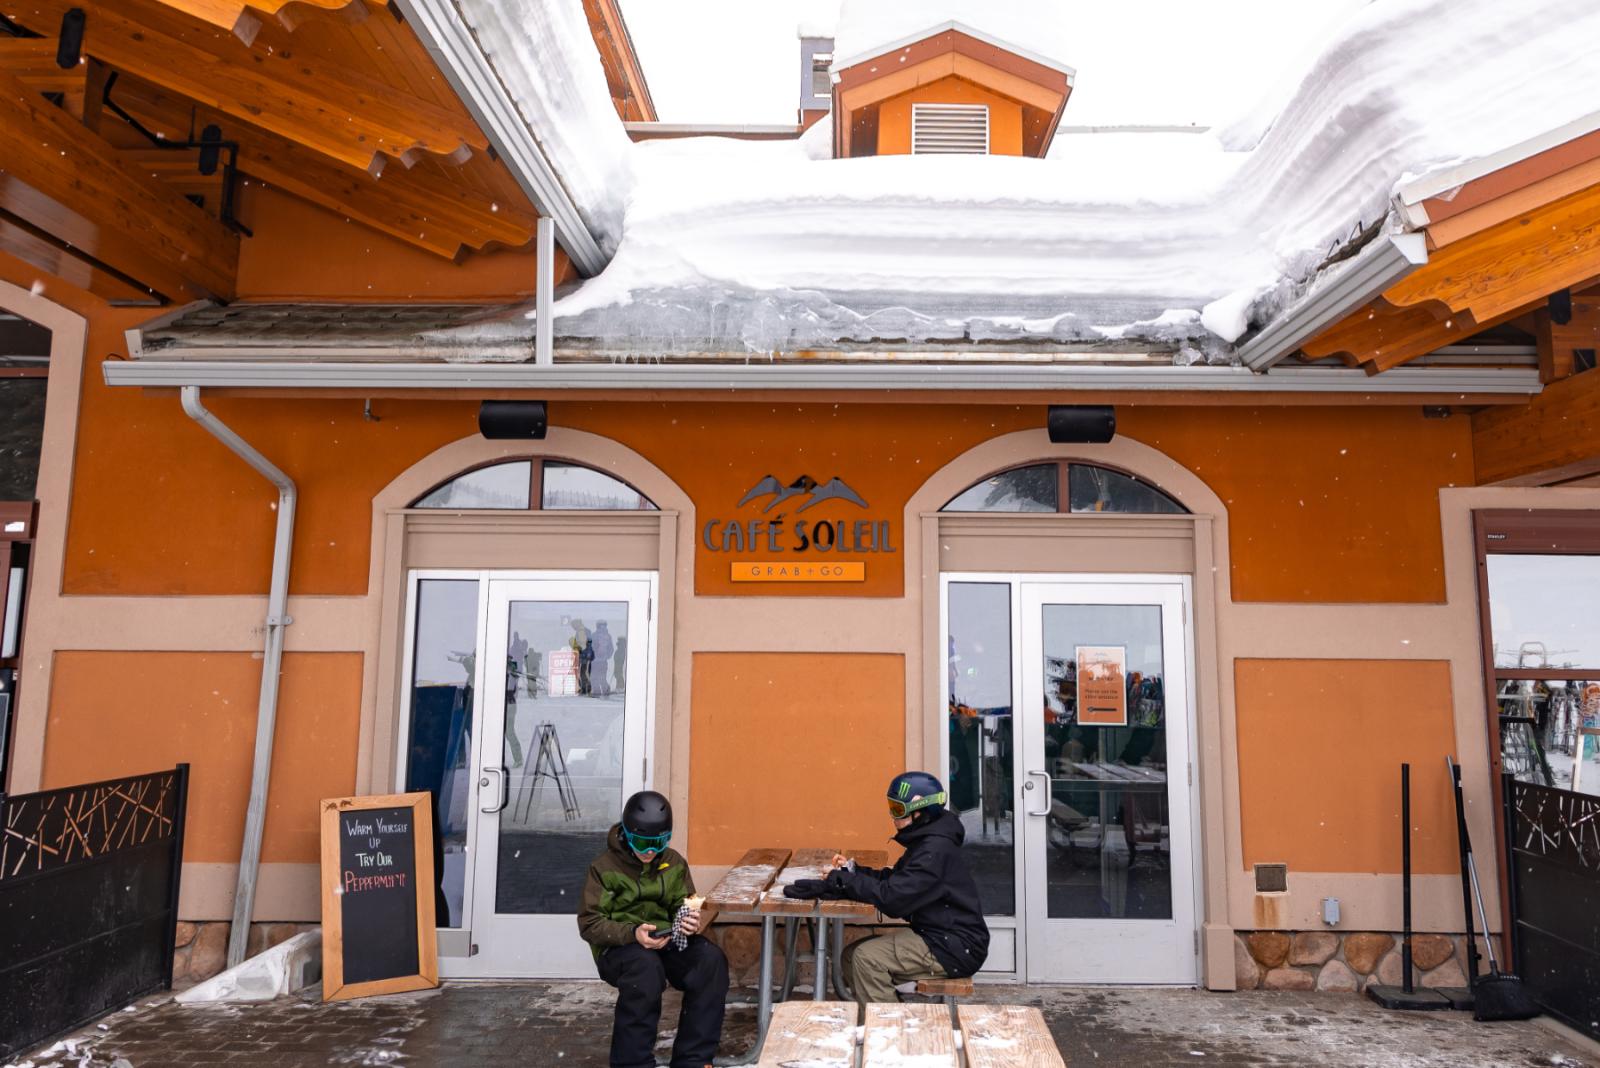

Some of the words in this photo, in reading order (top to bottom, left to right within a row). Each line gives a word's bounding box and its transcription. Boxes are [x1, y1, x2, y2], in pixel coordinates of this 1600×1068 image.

[703, 513, 784, 552] CAFÉ
[793, 520, 896, 552] SOLEIL
[751, 566, 800, 576] GRAB
[821, 566, 844, 576] GO
[355, 852, 375, 867] TRY
[376, 851, 393, 867] OUR
